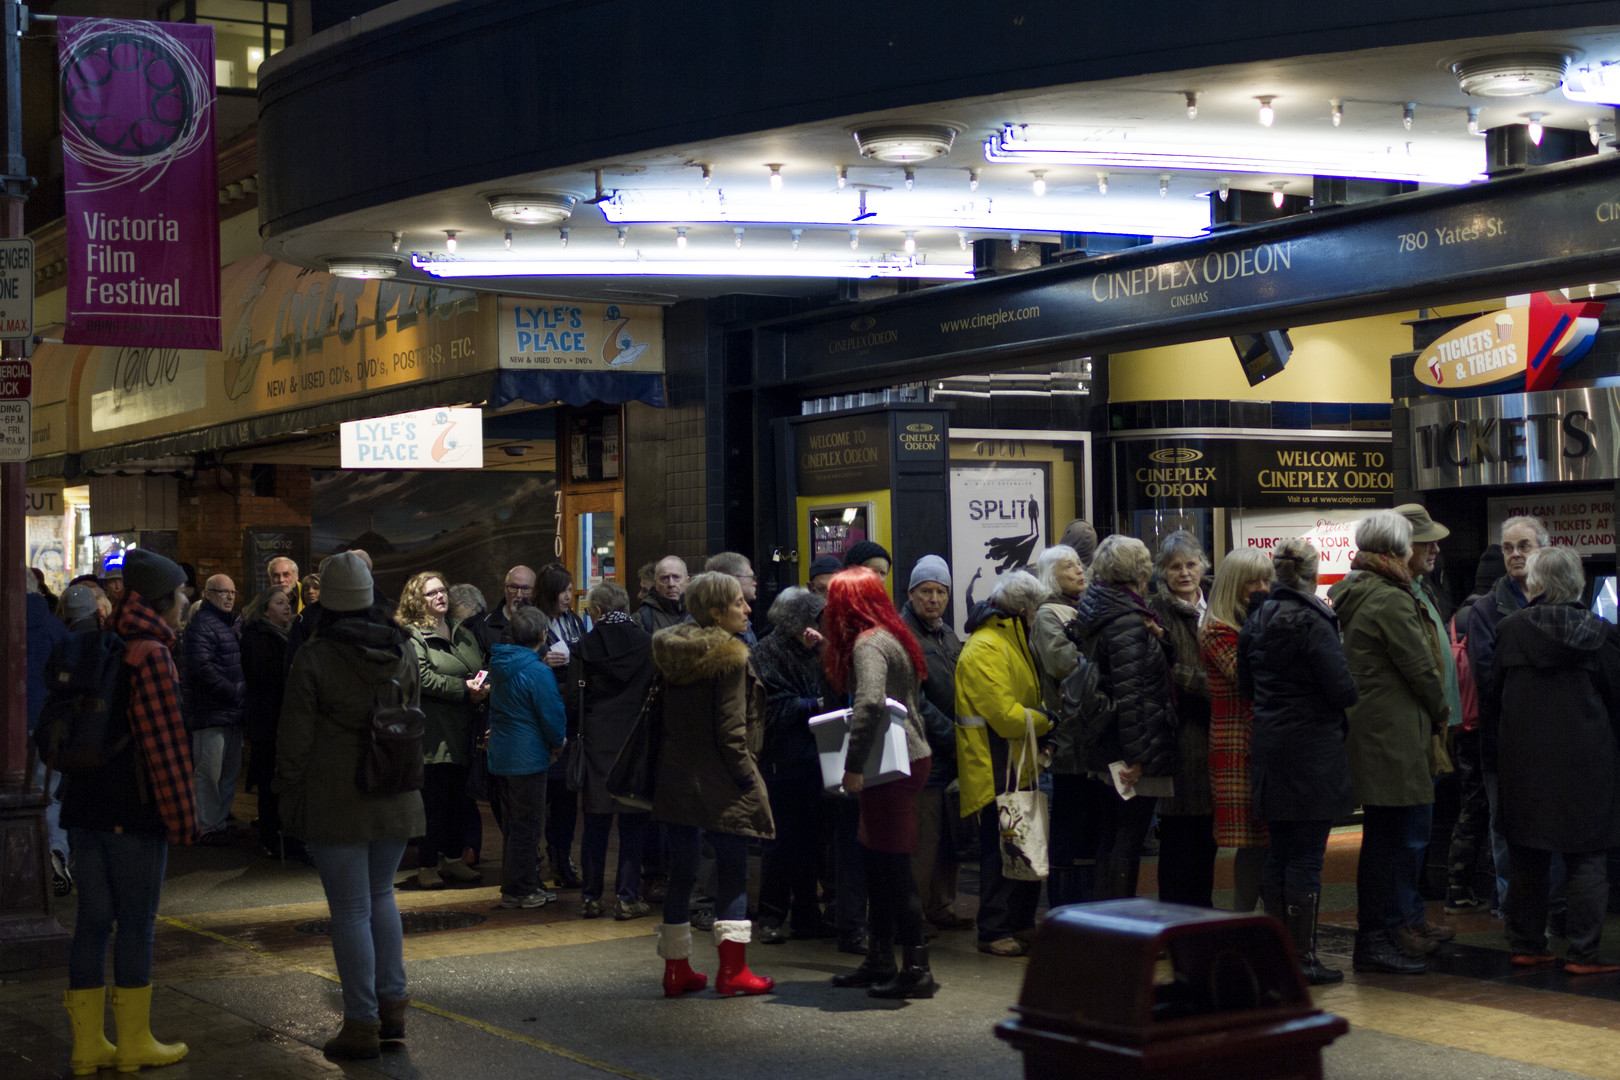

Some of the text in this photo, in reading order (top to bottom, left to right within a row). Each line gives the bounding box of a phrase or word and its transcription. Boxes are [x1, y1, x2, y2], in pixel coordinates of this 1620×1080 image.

[84, 211, 179, 242] Victoria
[1397, 217, 1508, 253] 780 Yates St.
[87, 244, 136, 273] Film
[1092, 241, 1292, 303] CINEPLEX ODEON
[86, 276, 180, 307] Festival
[1170, 290, 1209, 309] CINEMAS
[514, 306, 583, 331] LYLE'S
[940, 304, 1040, 334] www.cineplex.com
[517, 331, 586, 352] PLACE
[828, 329, 899, 354] CINEPLEX ODEON
[1437, 329, 1493, 363] TICKETS
[267, 378, 286, 398] NEW
[290, 376, 298, 394] &
[301, 371, 326, 393] USED
[450, 336, 476, 359] ETC.
[509, 356, 524, 365] NEW
[525, 356, 532, 365] &
[534, 356, 550, 365] USED
[1455, 344, 1518, 381] & TREATS
[355, 421, 417, 442] LYLE'S
[809, 430, 867, 450] WELCOME TO
[899, 432, 941, 443] CINEPLEX
[1416, 410, 1592, 470] TICKETS
[358, 443, 419, 461] PLACE
[802, 446, 879, 468] CINEPLEX ODEON
[904, 442, 936, 451] ODEON
[1277, 450, 1385, 468] WELCOME TO
[1136, 467, 1217, 482] CINEPLEX
[1258, 469, 1394, 489] CINEPLEX ODEO
[1145, 482, 1208, 498] ODEON
[1287, 495, 1301, 503] Visit
[1320, 496, 1376, 505] www.cineplex.com
[969, 500, 1027, 521] SPLIT
[1507, 505, 1530, 518] YOU
[1533, 504, 1555, 517] CAN
[1559, 503, 1586, 516] ALSO
[1554, 519, 1592, 531] TICKETS
[1596, 518, 1609, 530] AT
[1318, 537, 1350, 548] YOUR
